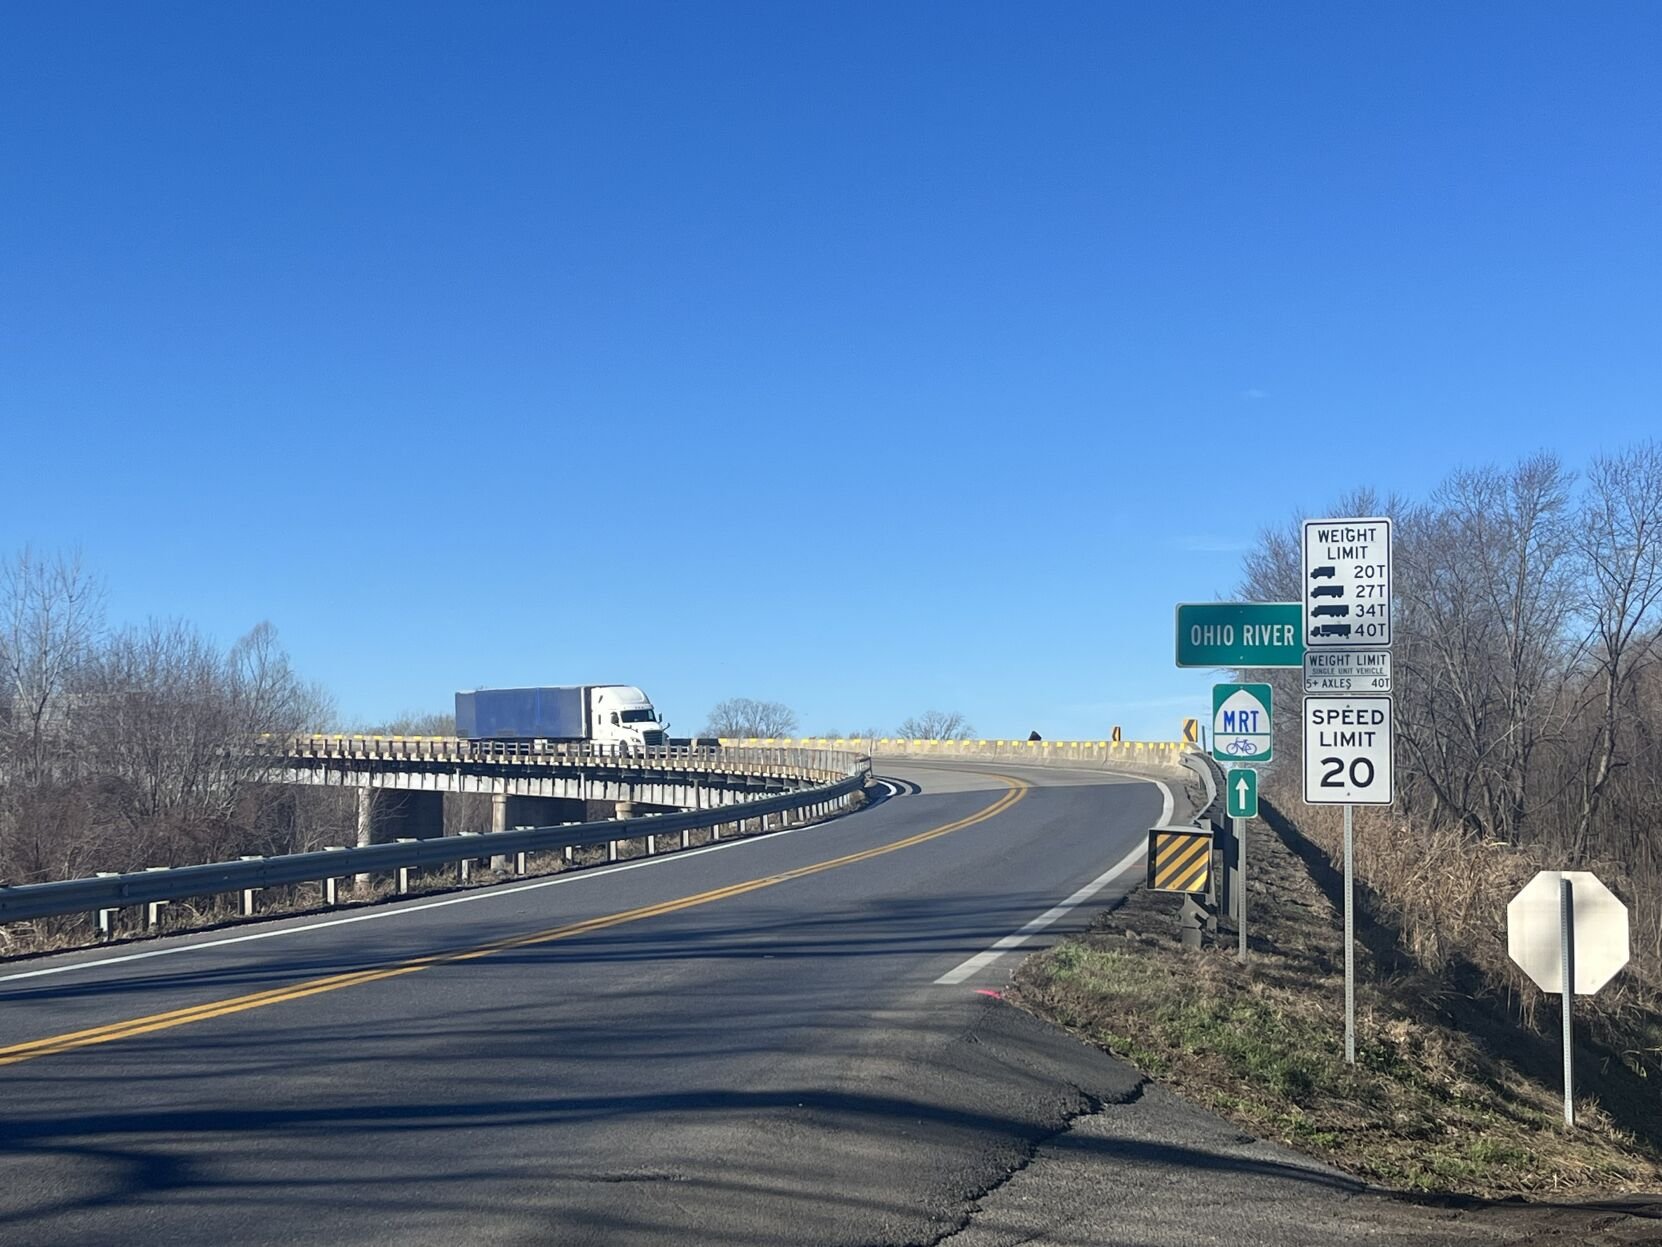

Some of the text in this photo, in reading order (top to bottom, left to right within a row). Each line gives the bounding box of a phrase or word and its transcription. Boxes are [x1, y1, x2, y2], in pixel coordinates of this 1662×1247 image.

[1318, 528, 1376, 543] WEIGHT
[1327, 546, 1368, 560] LIMIT
[1354, 565, 1386, 579] 20T
[1355, 584, 1386, 598] 27T
[1355, 604, 1386, 617] 34T
[1191, 624, 1294, 646] OHIO RIVER
[1354, 623, 1386, 637] 40T
[1309, 654, 1386, 666] WEIGHT LIMIT
[1312, 667, 1383, 675] SINGLE UNIT VEHICLE
[1306, 678, 1389, 688] 5+ AXLES 40T
[1223, 710, 1259, 733] MRT
[1312, 709, 1384, 725] SPEED
[1320, 731, 1376, 747] LIMIT
[1320, 757, 1374, 788] 20
